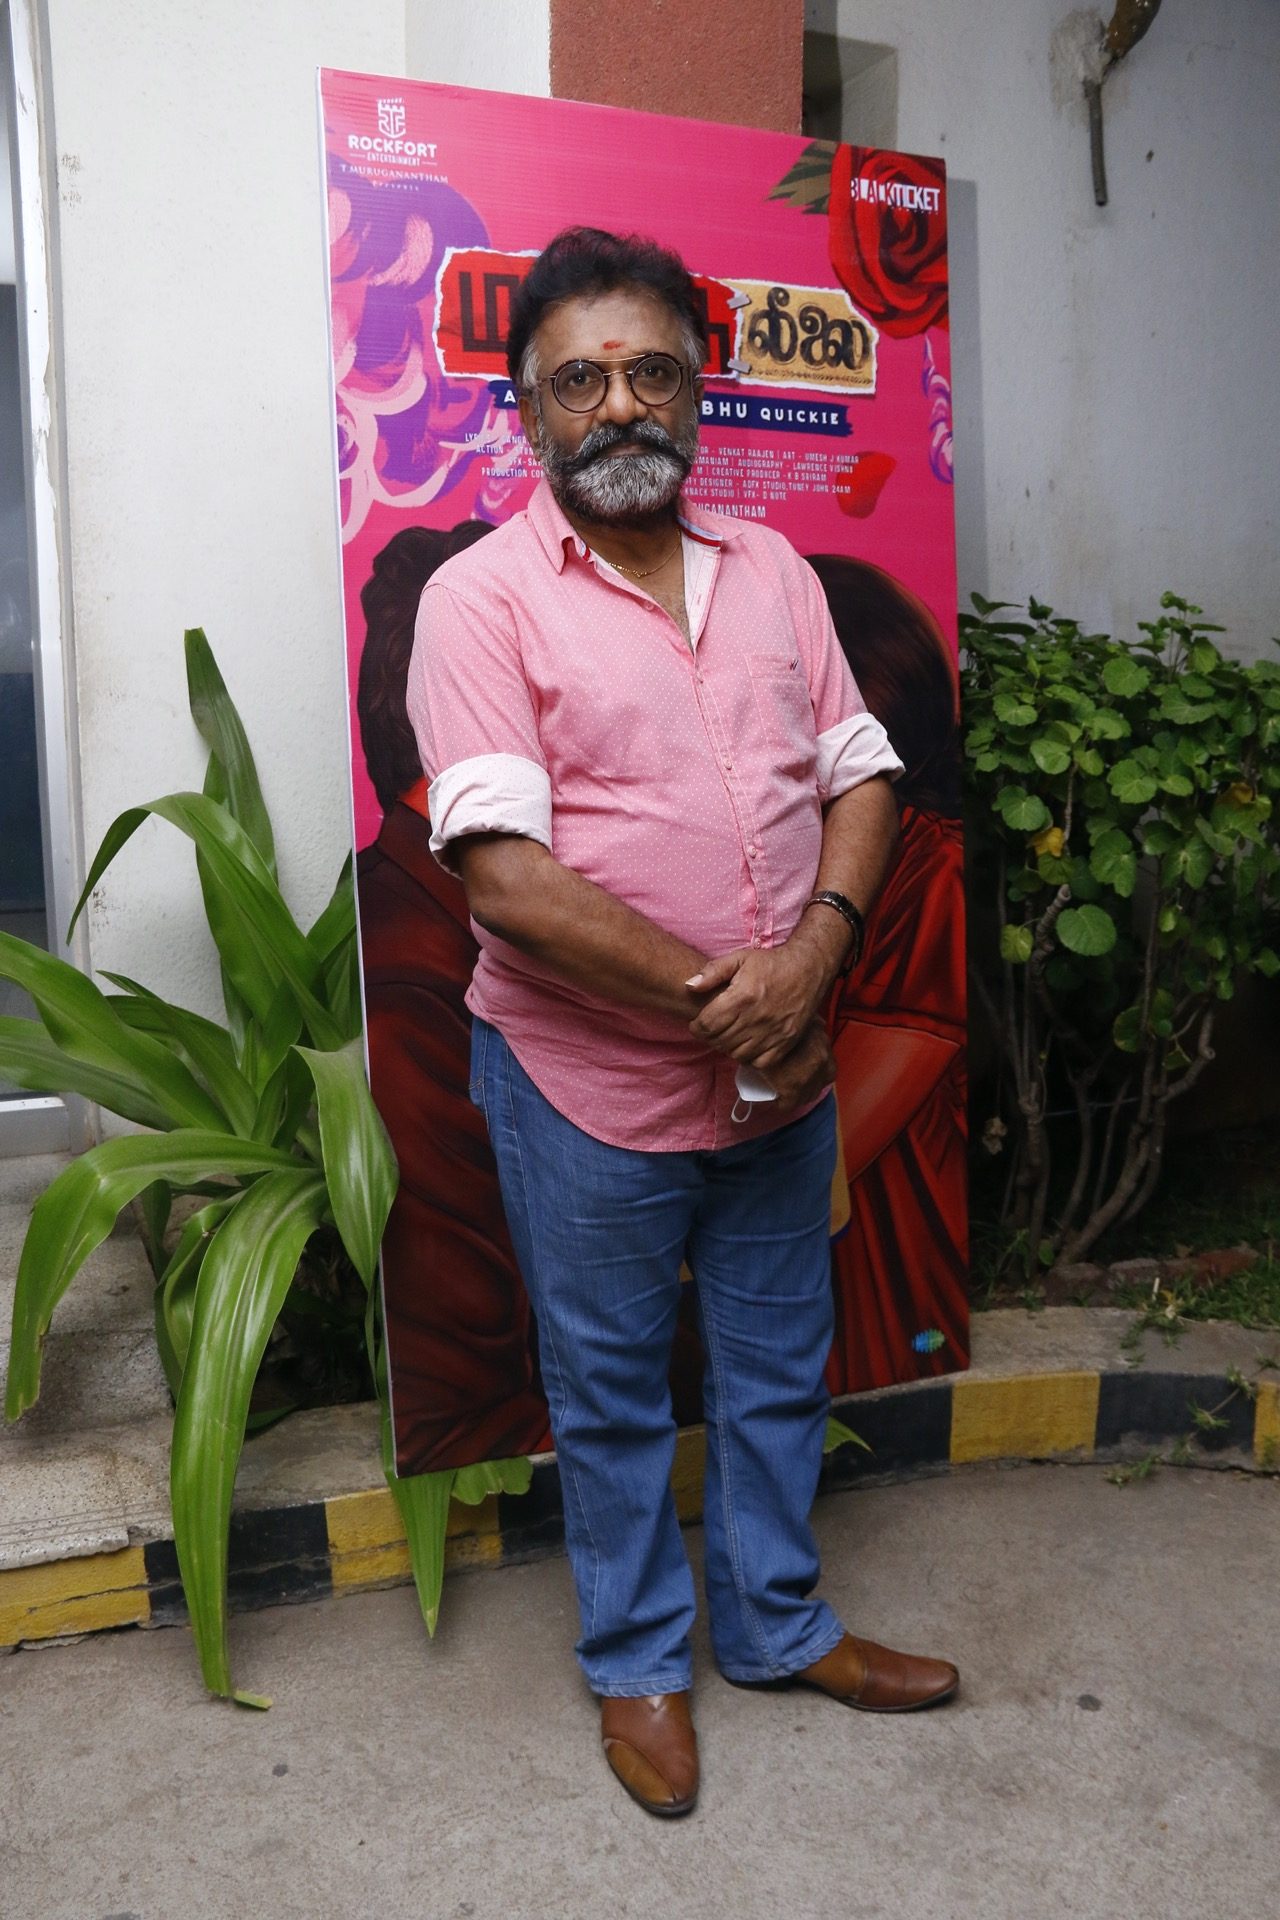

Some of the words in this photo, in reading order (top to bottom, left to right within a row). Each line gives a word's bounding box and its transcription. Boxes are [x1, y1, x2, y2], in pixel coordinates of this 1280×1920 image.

[347, 133, 437, 158] ROCKFORT
[367, 152, 420, 166] ENTERTAINMENT
[350, 165, 449, 184] MURUGANANTHAM
[701, 400, 748, 419] BHU
[760, 407, 839, 425] QUICKIE
[718, 447, 745, 456] VENKAT
[738, 459, 783, 468] AUDIOGRAPHY
[481, 467, 528, 477] PRODUCTION
[712, 467, 744, 477] CREATIVE
[747, 469, 781, 479] PRODUCER
[700, 478, 733, 488] DESIGNER
[711, 488, 735, 498] STUDIO
